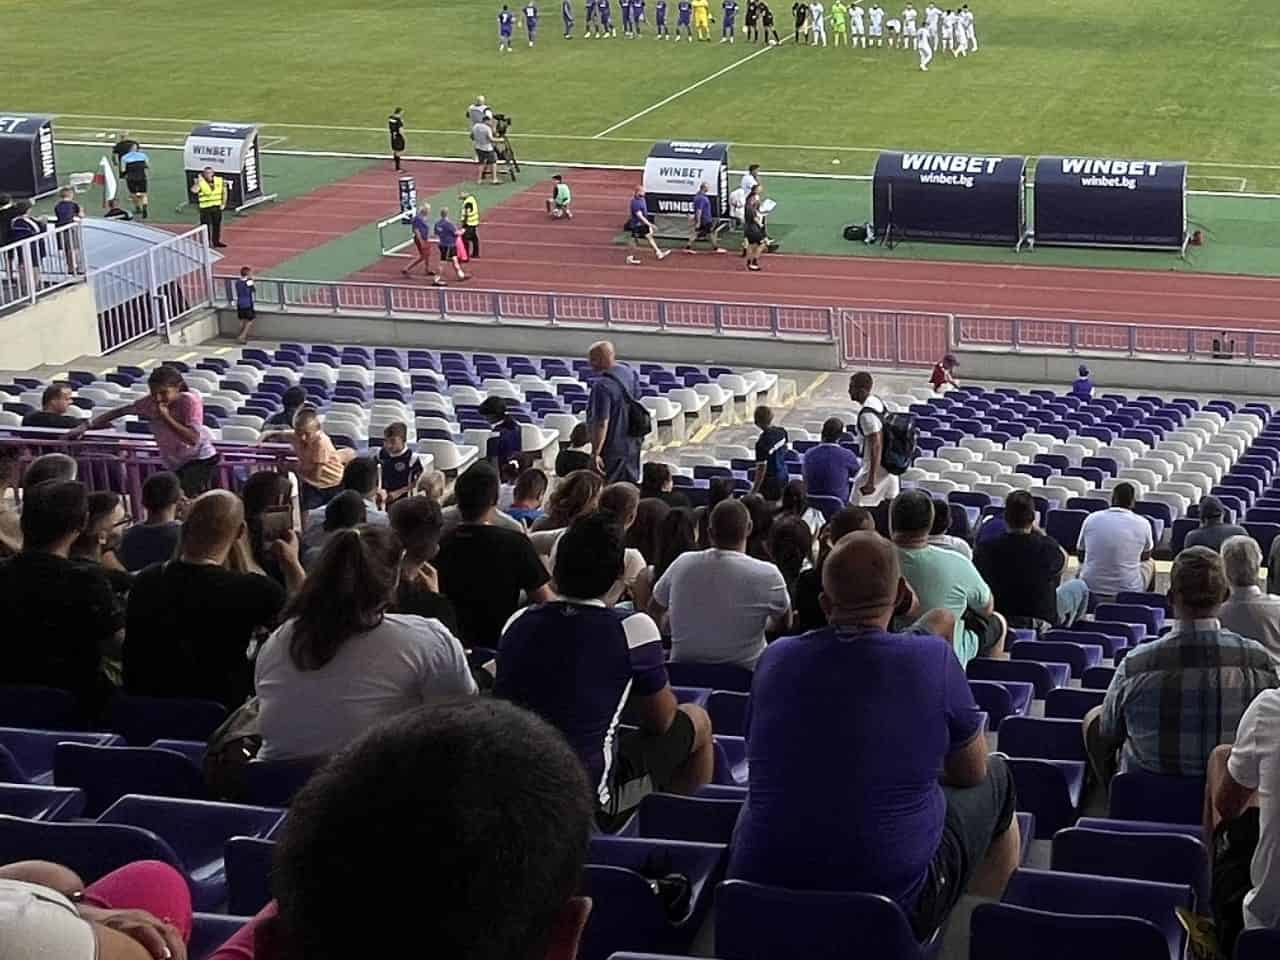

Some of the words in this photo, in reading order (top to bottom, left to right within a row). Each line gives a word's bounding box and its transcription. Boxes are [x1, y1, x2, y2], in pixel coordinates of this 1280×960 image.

[193, 144, 232, 157] WINBET
[902, 153, 1002, 174] WINBET
[1062, 158, 1162, 176] WINBET
[660, 166, 704, 178] WINBET
[920, 173, 974, 187] winbet.bg
[1081, 176, 1136, 189] winbet.bg
[658, 200, 695, 212] WINBE
